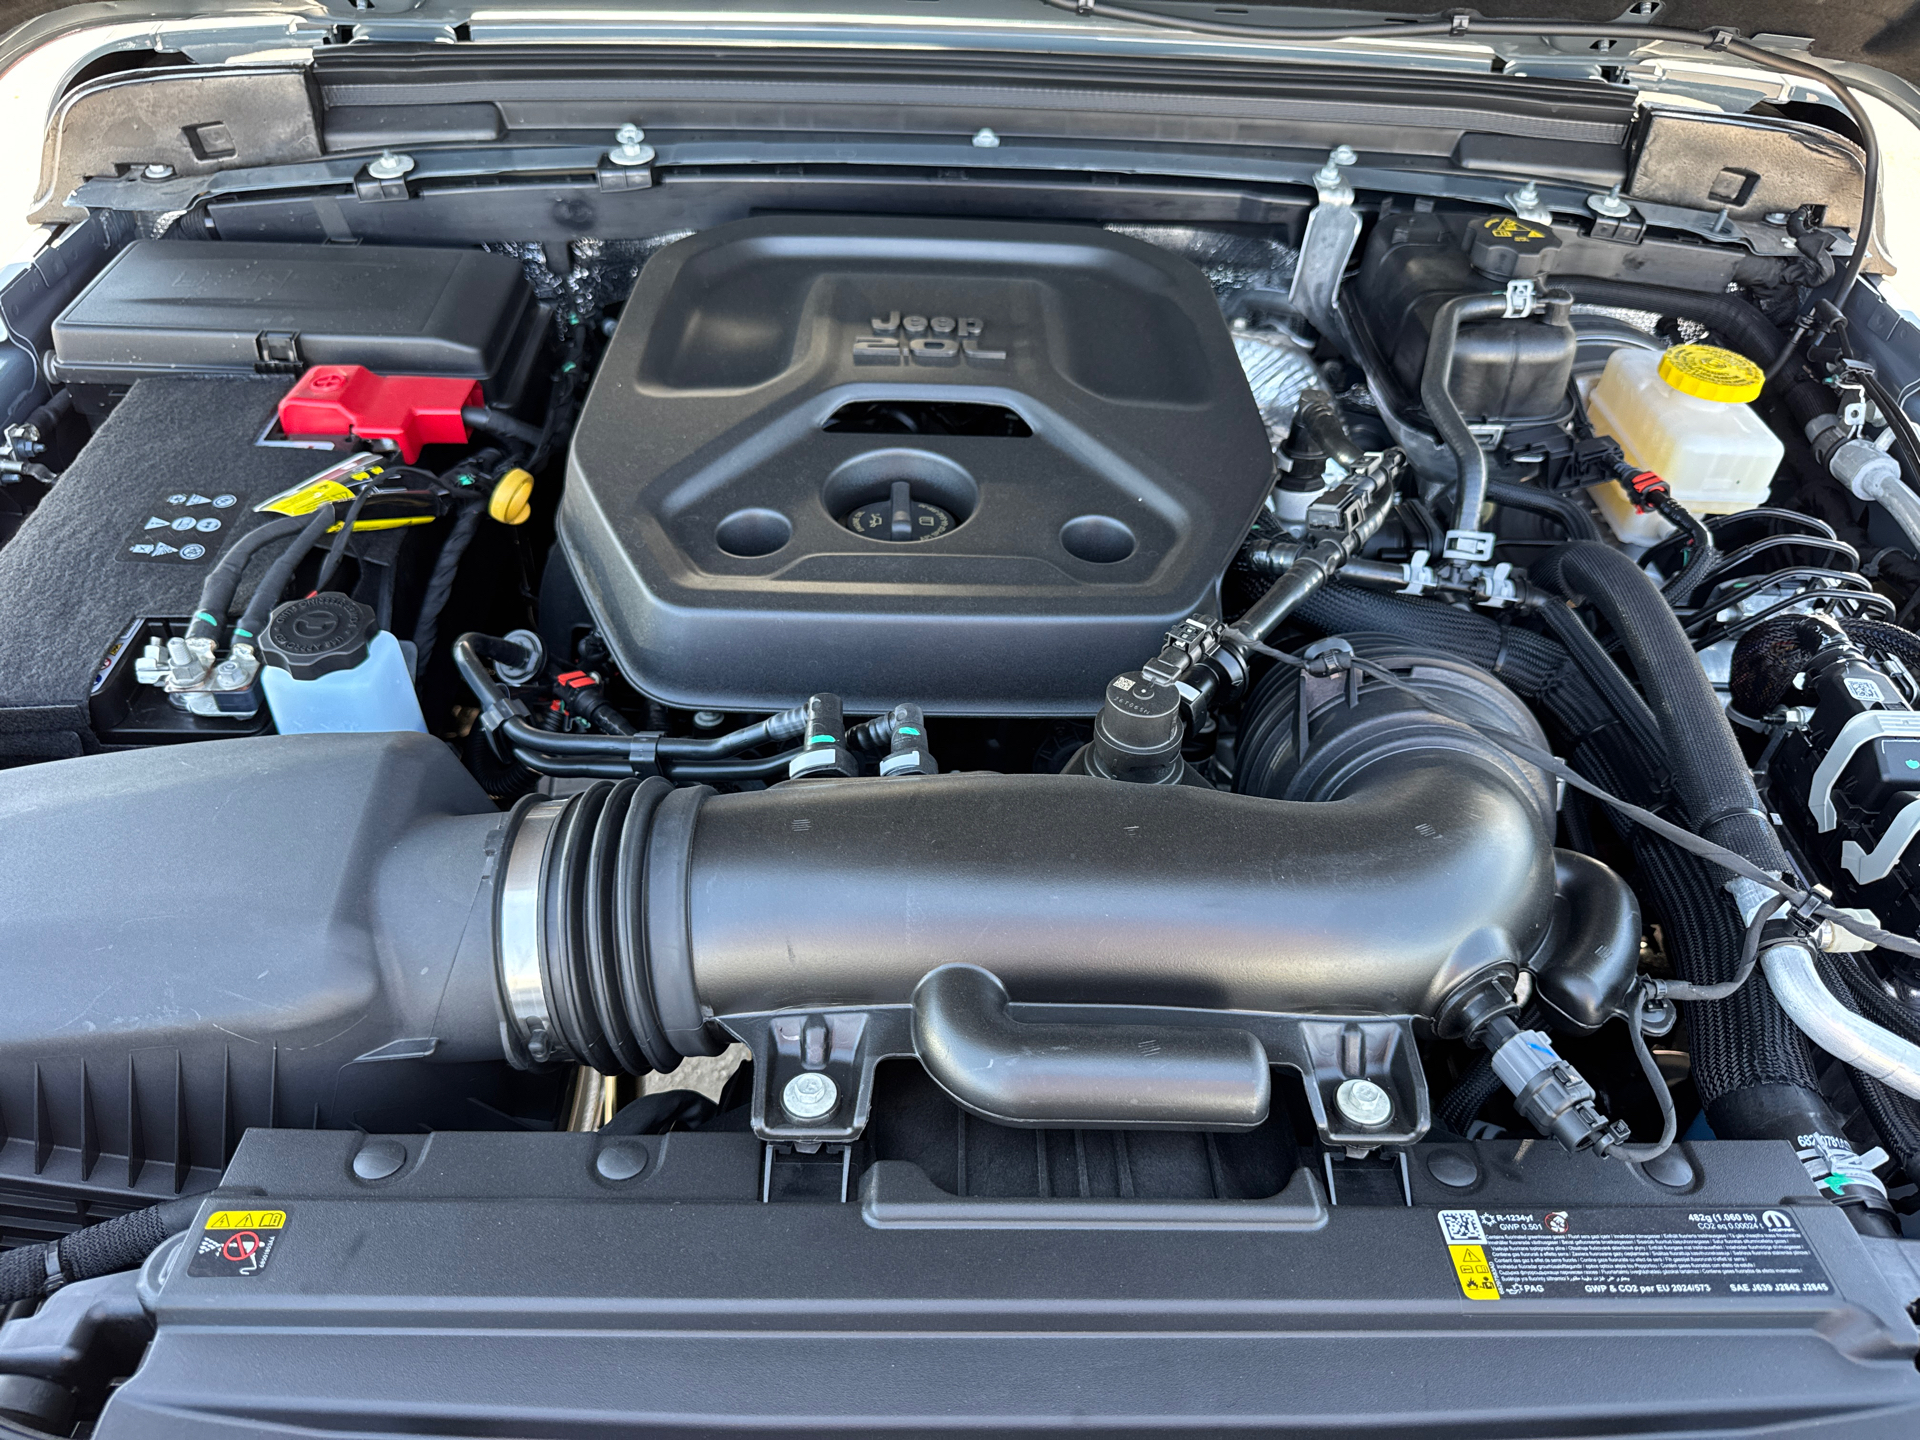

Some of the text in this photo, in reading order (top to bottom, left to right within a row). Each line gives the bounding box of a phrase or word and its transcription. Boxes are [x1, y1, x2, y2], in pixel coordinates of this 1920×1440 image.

[871, 311, 984, 337] Jeep
[853, 337, 1006, 361] 2.0L
[298, 597, 345, 610] STEERING
[275, 605, 298, 624] FLUID
[274, 633, 321, 652] APPROVED
[1688, 1213, 1757, 1223] 482g (1.060 lb)
[1499, 1223, 1543, 1231] GWP 0.501
[1697, 1222, 1716, 1230] CO2
[1717, 1223, 1728, 1231] eq
[1729, 1222, 1759, 1230] 0.00024
[1524, 1284, 1545, 1293] PAG
[1584, 1284, 1711, 1294] GWP & CO2 per EU 2024/573
[1729, 1283, 1829, 1292] SAE J639 J2842 J2845
